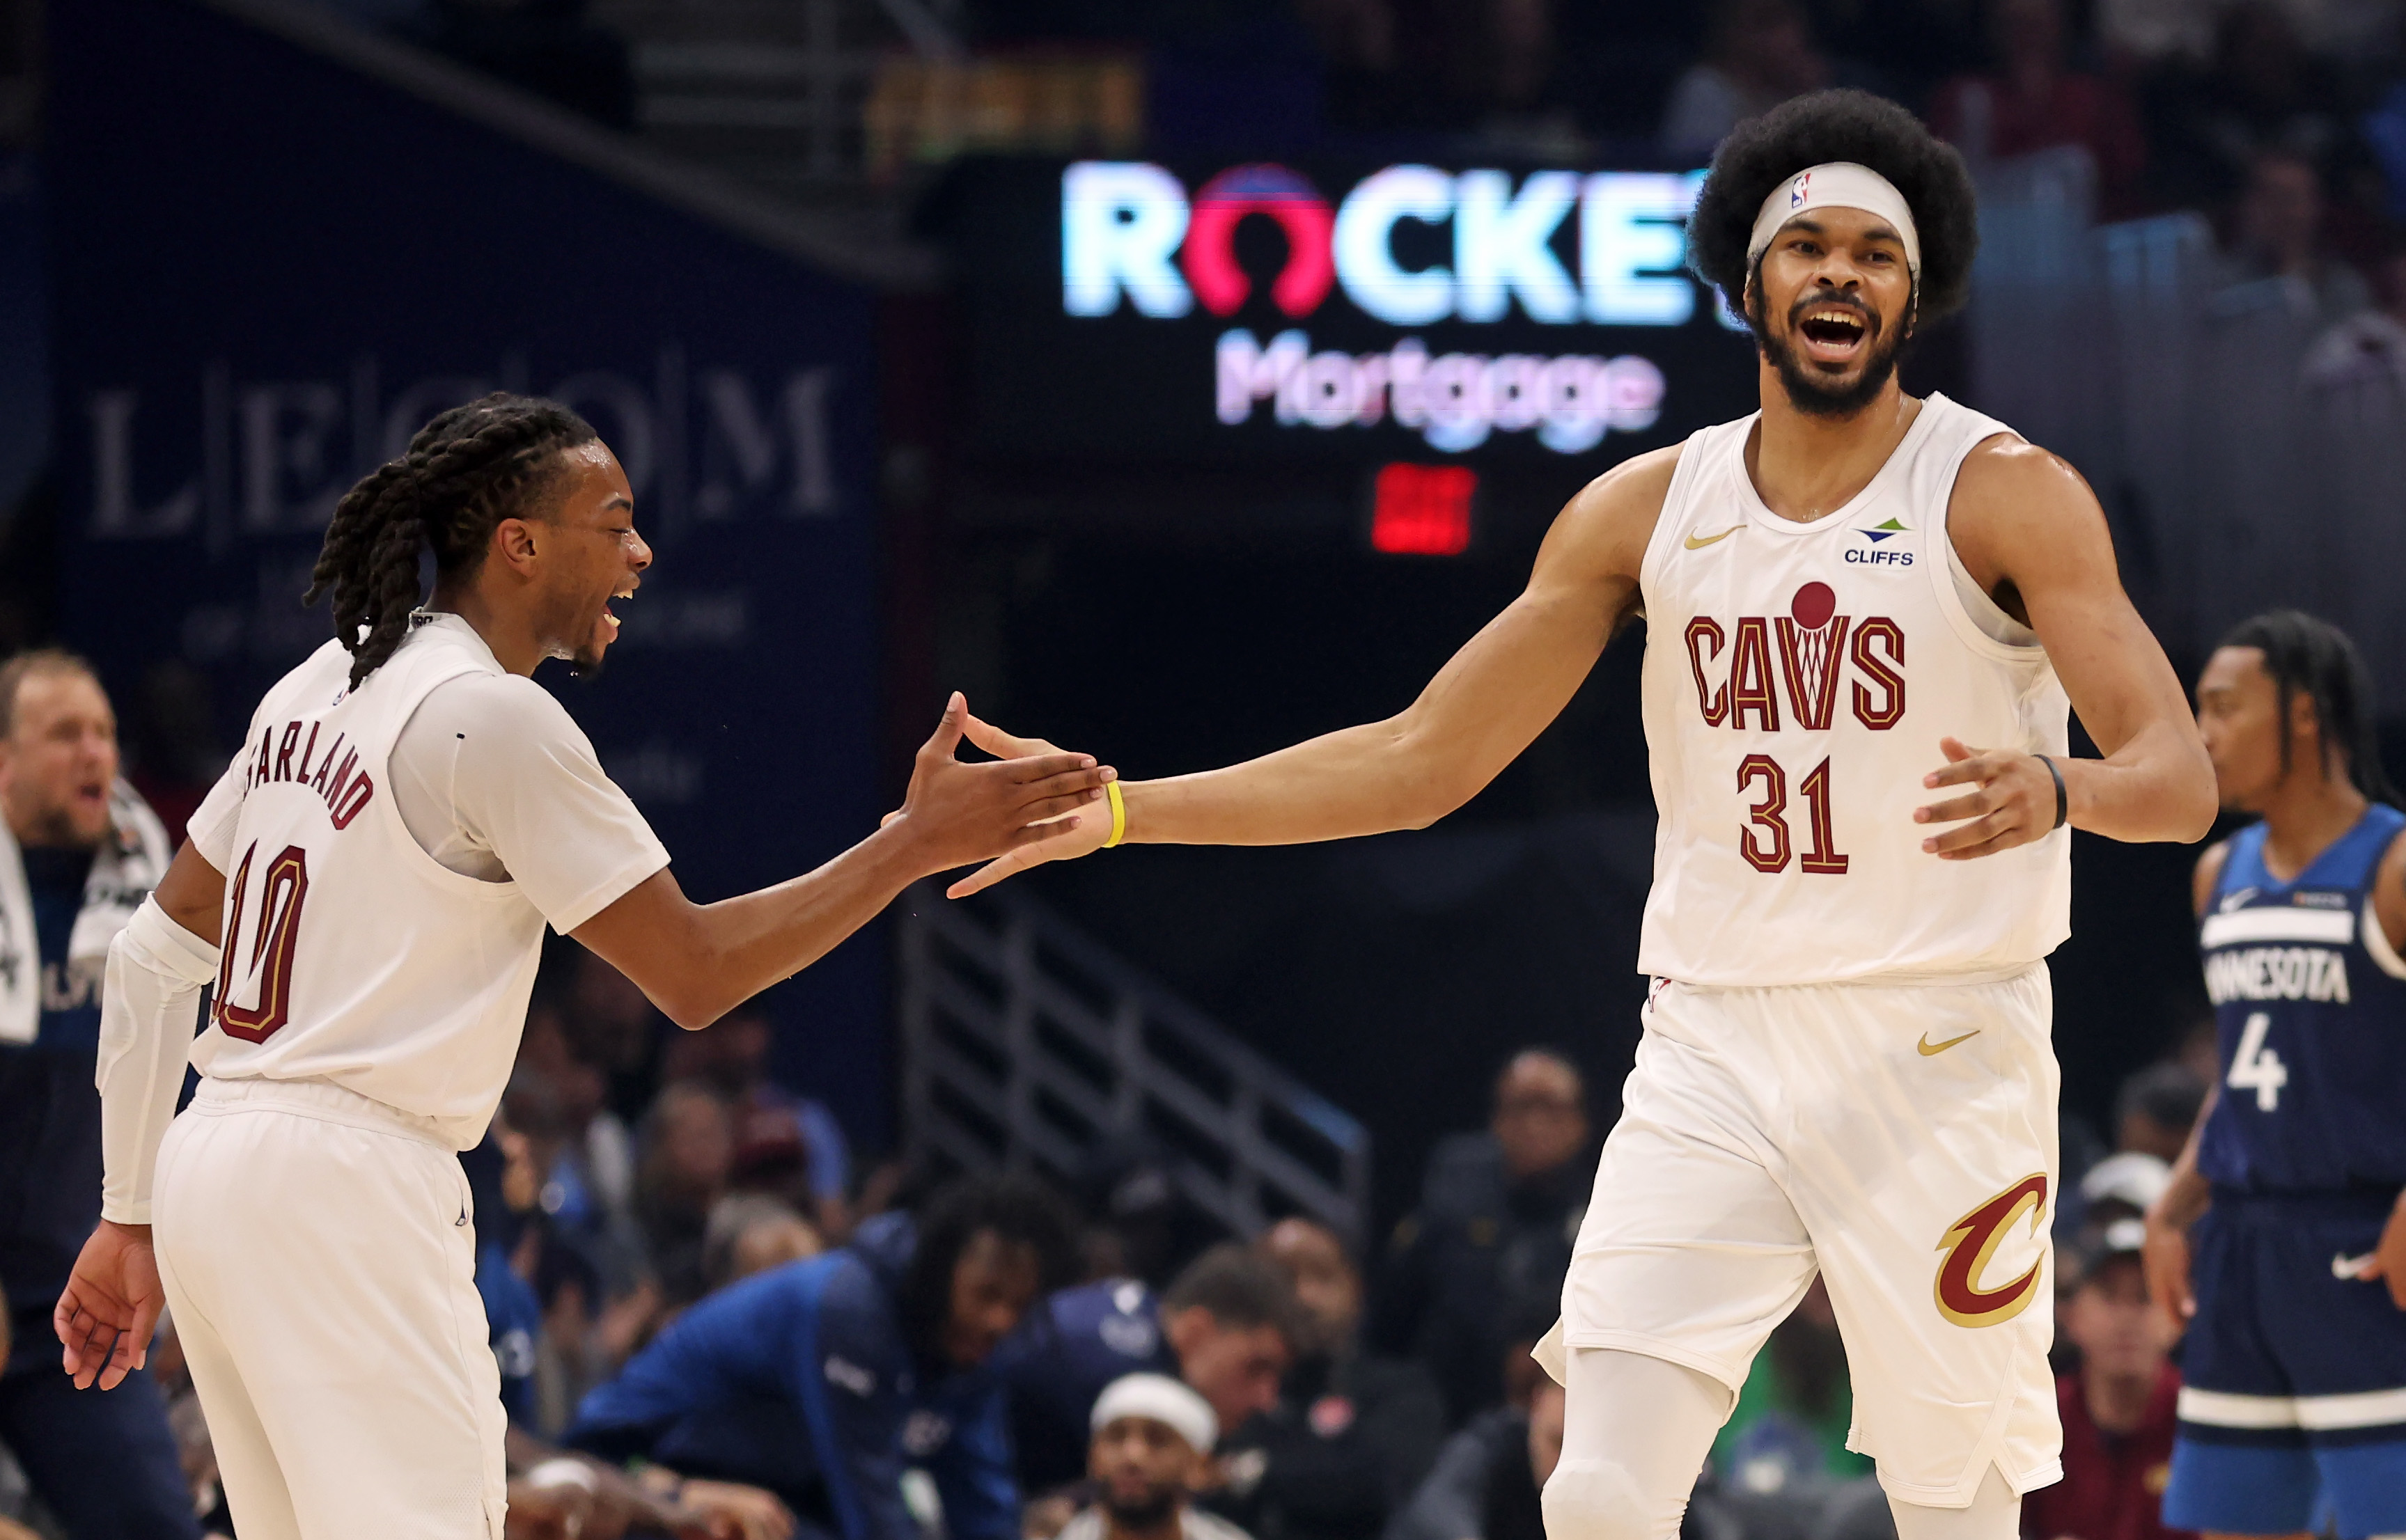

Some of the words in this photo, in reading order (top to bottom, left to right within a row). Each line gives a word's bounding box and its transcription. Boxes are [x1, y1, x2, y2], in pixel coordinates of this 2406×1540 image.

[1061, 161, 1751, 331] ROCKE
[1215, 327, 1665, 453] Mortgage
[1844, 549, 1914, 566] CLIFFS
[1684, 615, 1905, 732] CAVS
[1737, 754, 1849, 874] 31
[211, 838, 308, 1045] 10
[2226, 1012, 2288, 1112] 4
